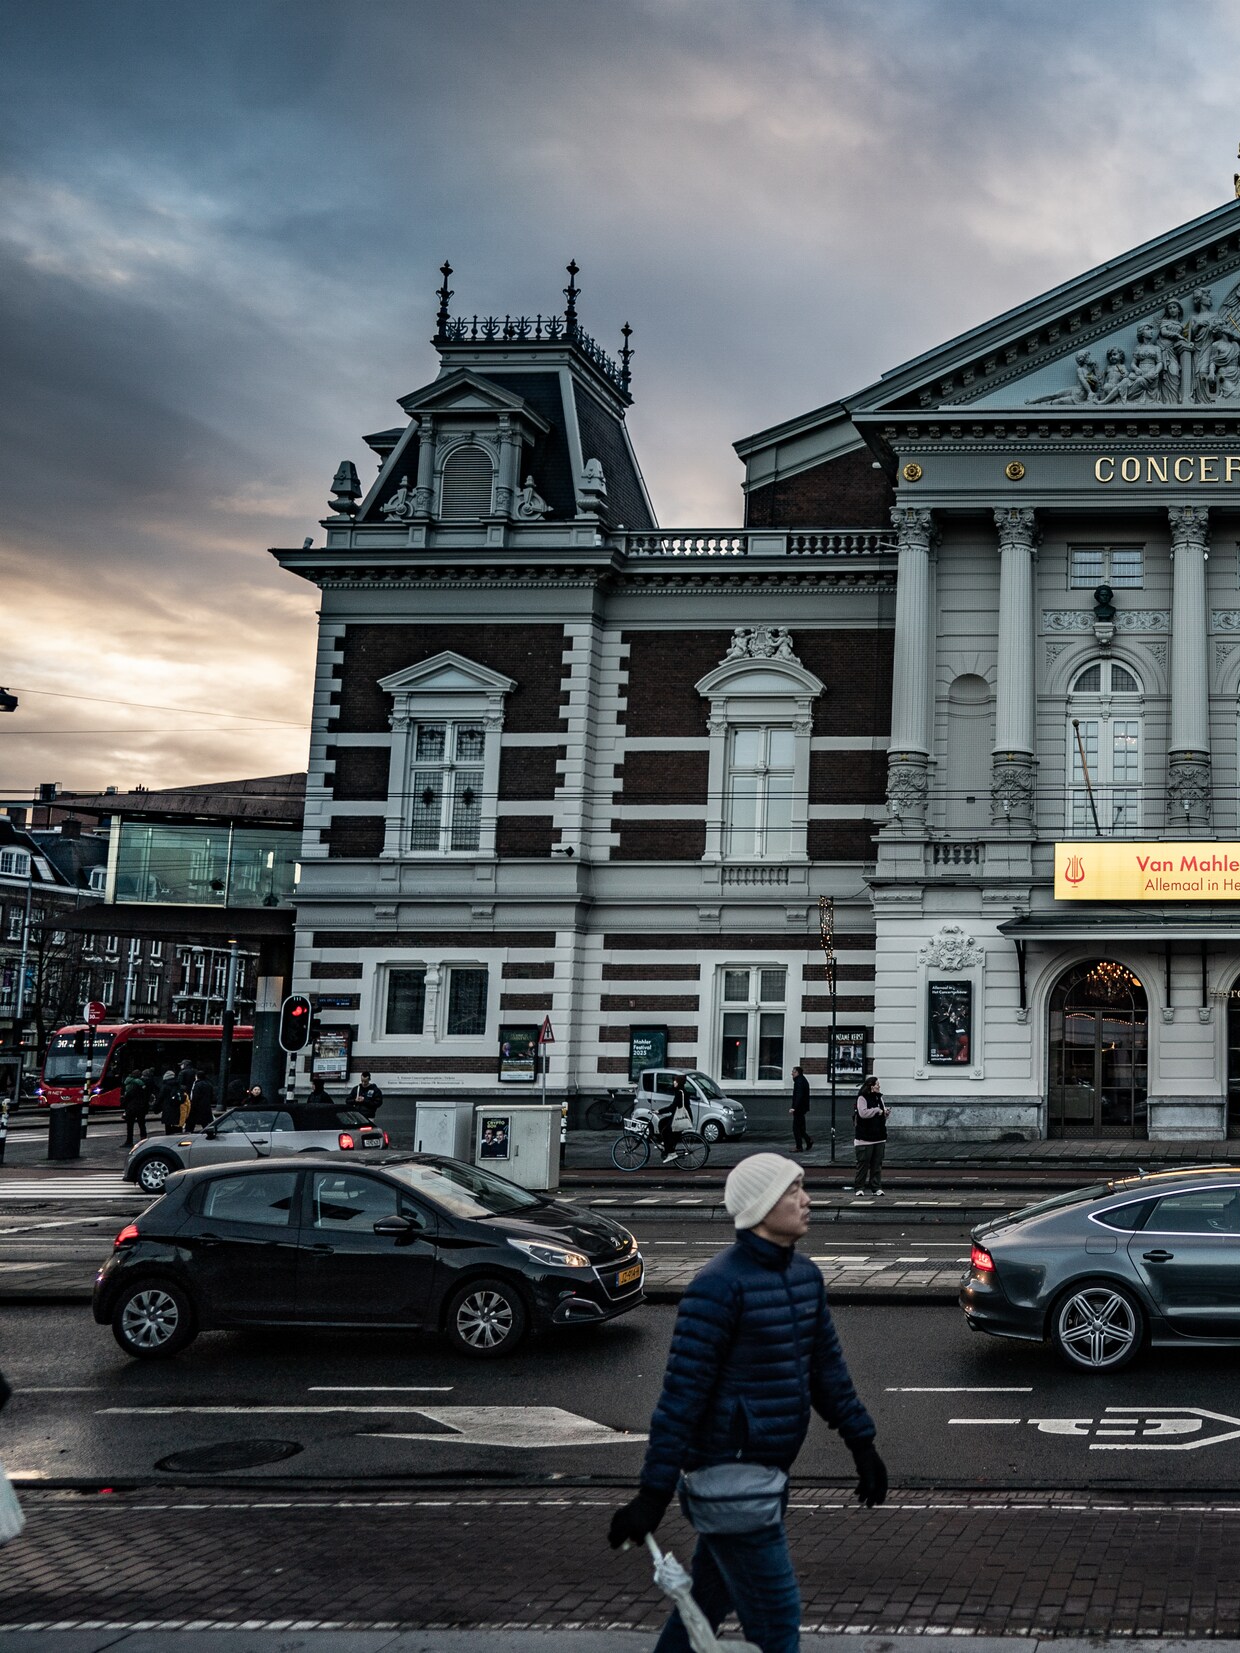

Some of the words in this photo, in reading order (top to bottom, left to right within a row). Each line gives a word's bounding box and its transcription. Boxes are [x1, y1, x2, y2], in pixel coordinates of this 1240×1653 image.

[1136, 856, 1174, 872] Van
[1145, 878, 1203, 891] Allemaal
[1207, 878, 1218, 891] in
